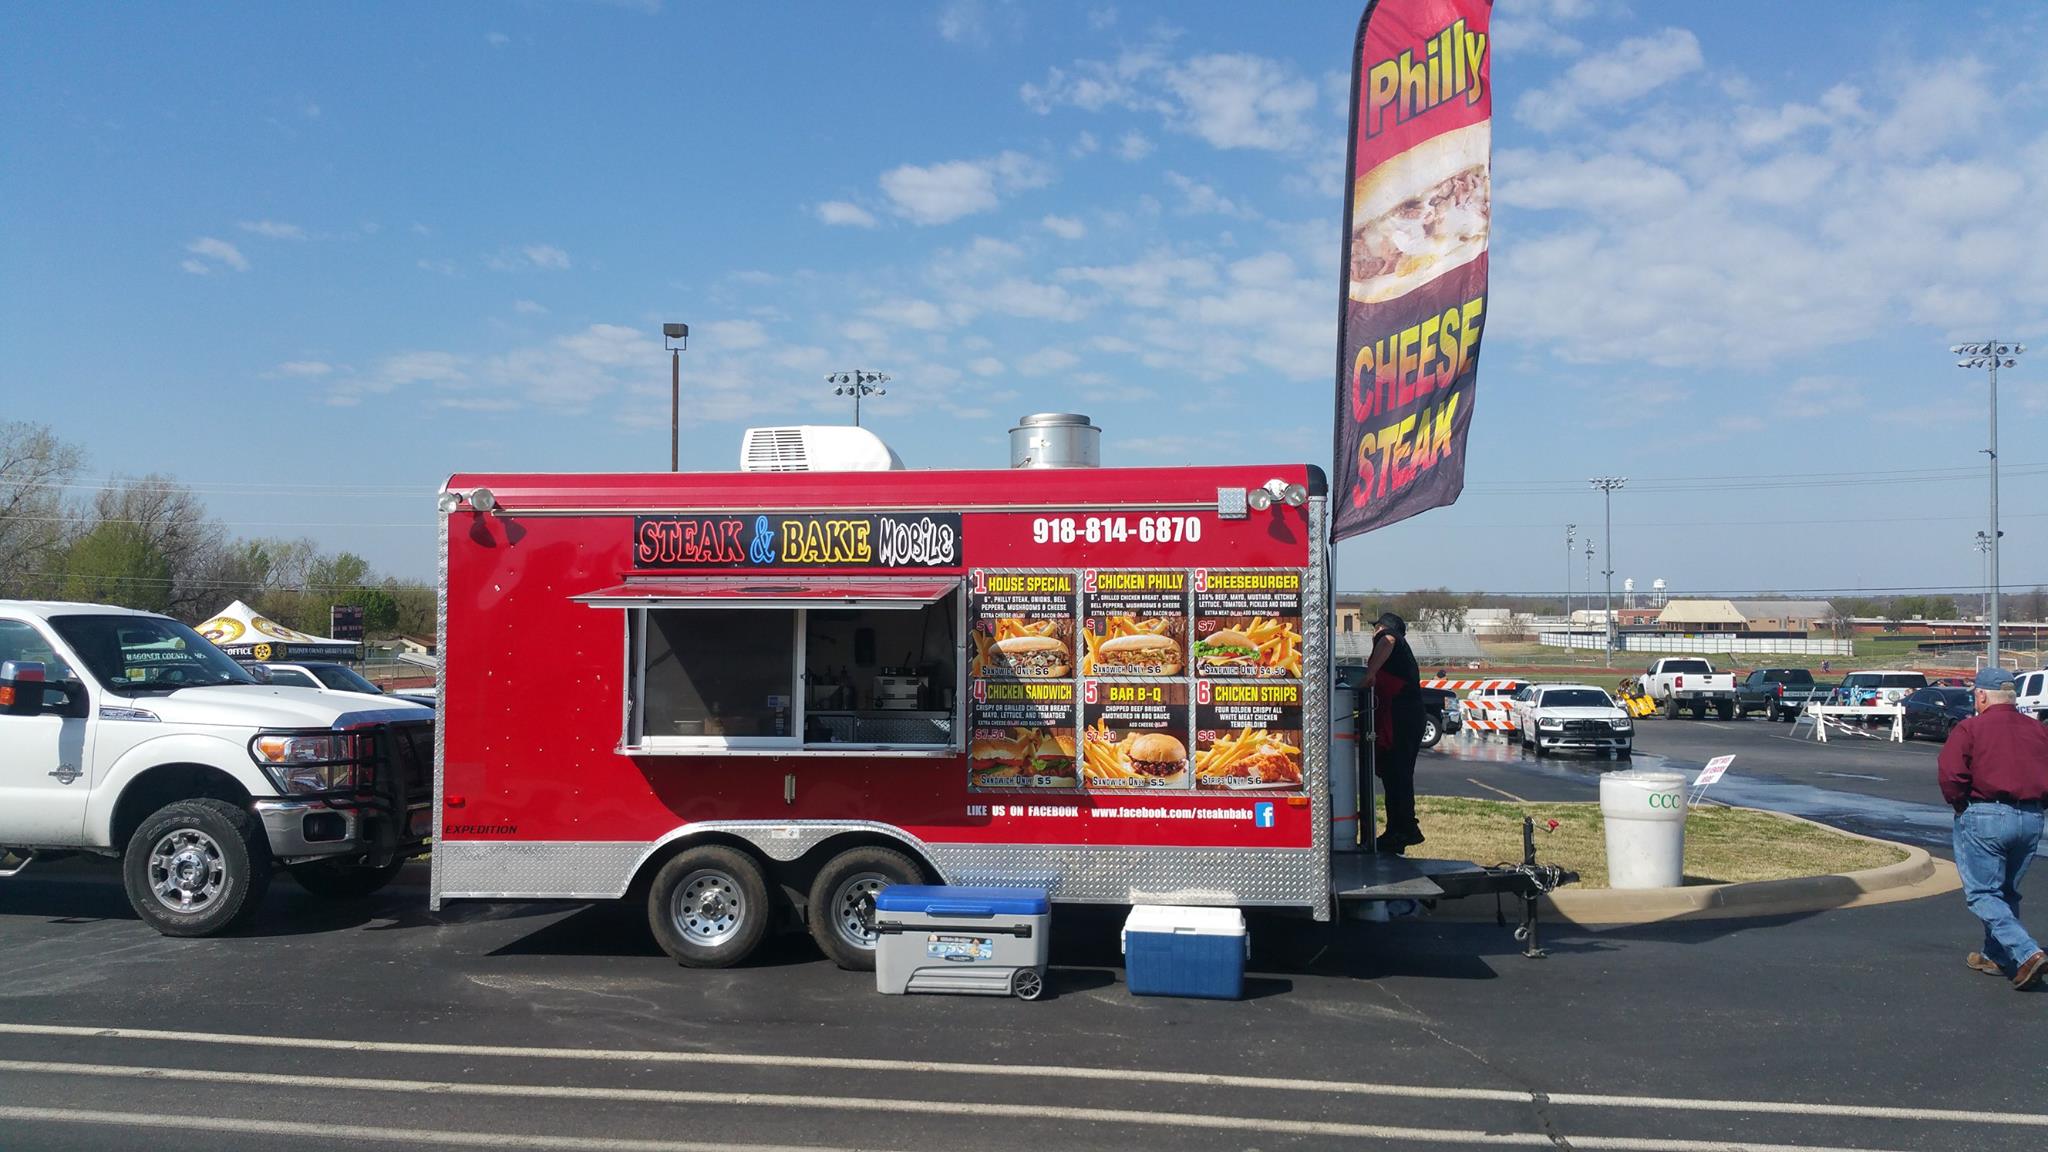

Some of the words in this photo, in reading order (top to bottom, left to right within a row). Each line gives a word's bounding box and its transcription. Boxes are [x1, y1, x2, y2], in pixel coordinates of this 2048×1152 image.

[1366, 17, 1488, 140] Philly
[1353, 297, 1482, 423] CHEESE
[1352, 391, 1460, 509] STEAK
[1033, 516, 1201, 543] 918-814-6870
[639, 520, 745, 563] STEAK
[750, 515, 776, 564] &
[782, 520, 871, 563] BAKE
[975, 570, 987, 594] 1
[988, 576, 1025, 592] HOUSE
[1027, 576, 1071, 592] SPECIAL
[1084, 568, 1097, 593] 2
[1098, 574, 1145, 590] CHICKEN
[1148, 574, 1184, 590] PHILLY
[1195, 568, 1207, 592] 3
[1207, 575, 1299, 589] CHEESEBURGER
[1198, 620, 1216, 631] $7
[1034, 667, 1049, 675] $6
[1147, 666, 1161, 674] $6
[1260, 666, 1286, 675] $4.50
[974, 679, 987, 704] 4
[987, 684, 1024, 700] CHICKEN
[1025, 684, 1072, 700] SANDWICH
[1084, 679, 1098, 704] 5
[1110, 687, 1134, 701] BAR
[1137, 687, 1161, 702] B-Q
[1197, 679, 1210, 704] 6
[1215, 686, 1258, 702] CHICKEN
[1261, 686, 1297, 702] STRIPS
[1197, 730, 1216, 741] $8
[1037, 777, 1051, 785] $5
[1150, 778, 1165, 786] $5
[1247, 777, 1262, 785] $6
[1648, 793, 1680, 808] CCC
[967, 805, 987, 816] LIKE
[991, 805, 1006, 816] US
[1009, 805, 1023, 817] ON
[1028, 806, 1079, 817] FACEBOOK
[1091, 807, 1253, 820] www.facebook.com/steaknbake
[445, 825, 517, 834] EXPEDITION
